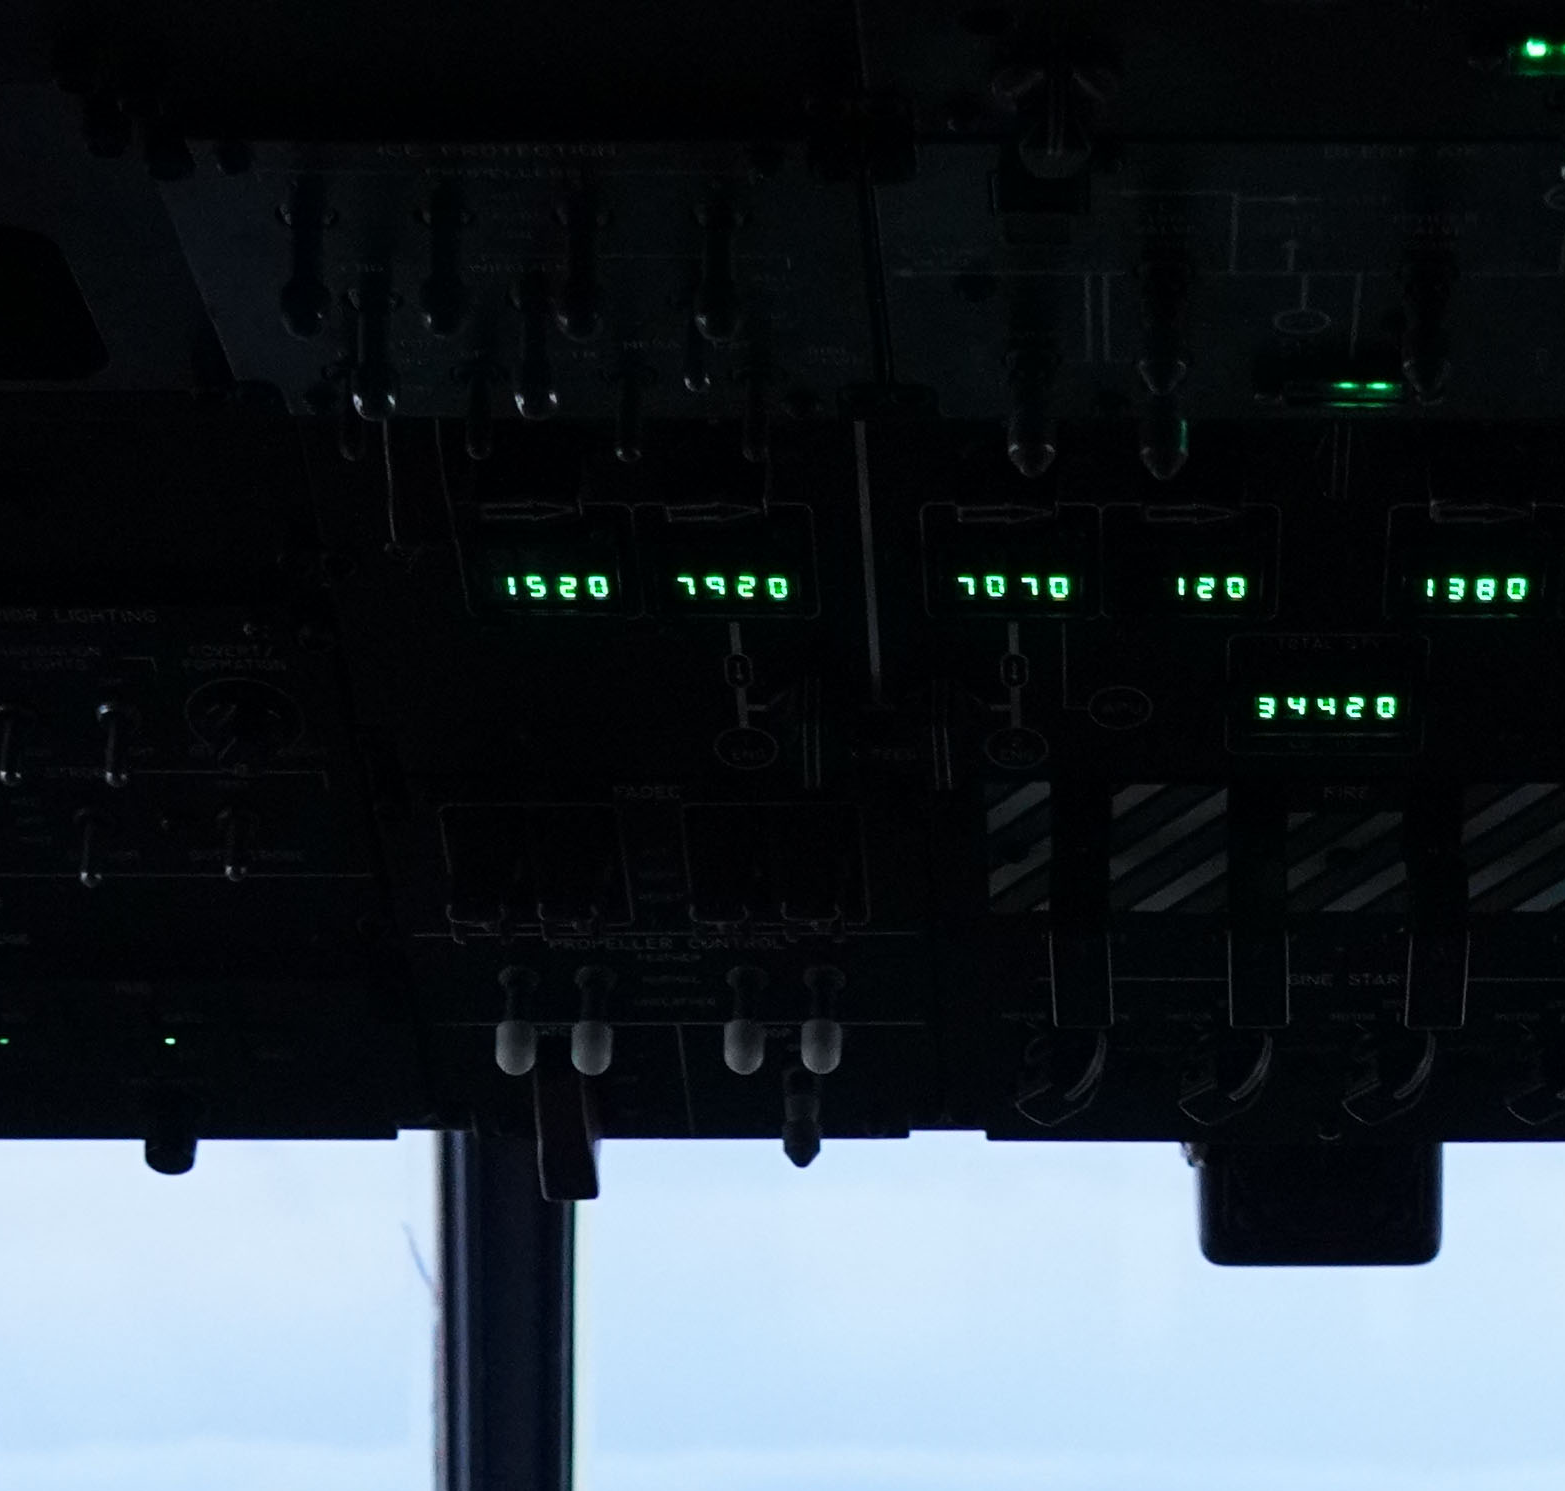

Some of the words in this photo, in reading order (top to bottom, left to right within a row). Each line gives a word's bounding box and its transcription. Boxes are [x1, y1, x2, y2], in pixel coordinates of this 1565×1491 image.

[507, 575, 608, 600] 1520
[677, 575, 788, 600] 7920
[958, 575, 1070, 600] 7070
[1178, 576, 1247, 600] 120
[1427, 577, 1528, 601] 1380
[53, 608, 158, 625] LIGHTING
[1259, 696, 1397, 719] 34420
